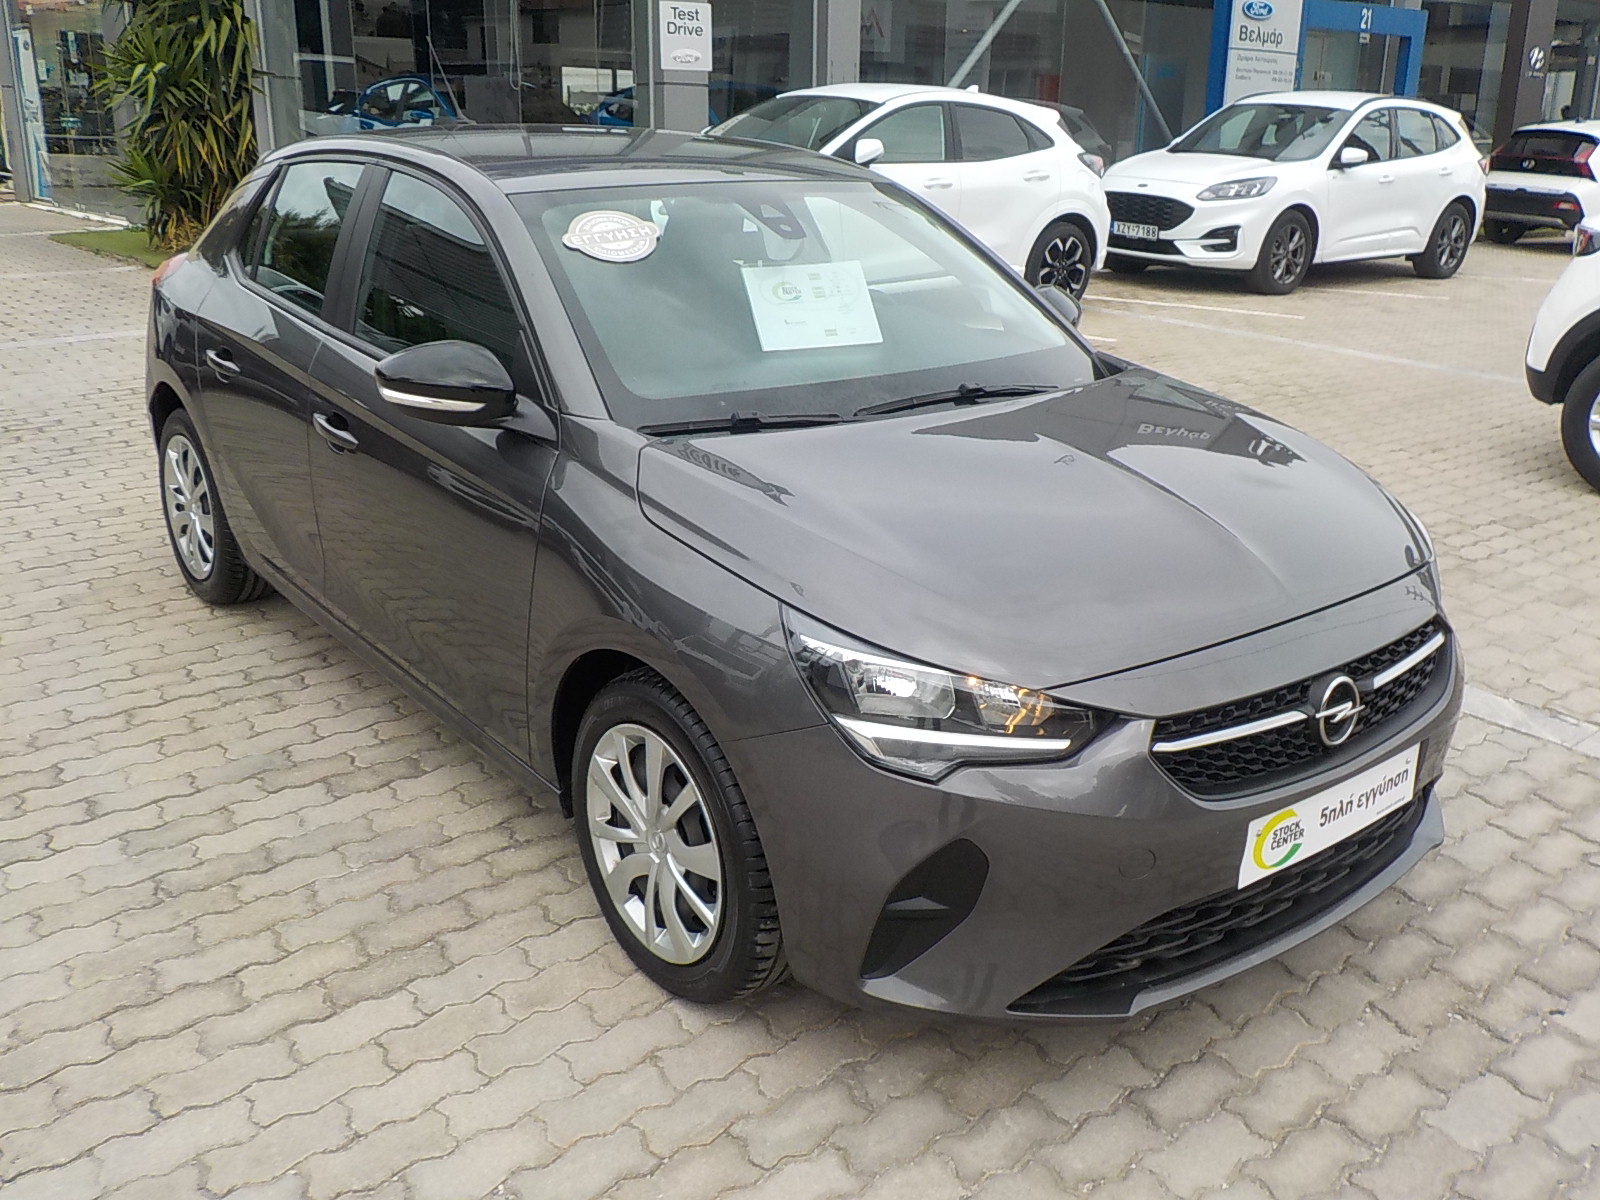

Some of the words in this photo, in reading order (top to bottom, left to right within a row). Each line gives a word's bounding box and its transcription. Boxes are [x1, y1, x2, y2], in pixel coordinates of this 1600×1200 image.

[670, 6, 700, 21] Test
[1250, 1, 1269, 15] Ford
[1360, 7, 1373, 30] 21
[667, 21, 703, 37] Drive
[1239, 25, 1283, 47] Βελμάρ
[570, 226, 653, 245] ΕΓΓΥΗΣΗ
[1319, 792, 1354, 828] 5πλή
[1356, 768, 1409, 811] εγγύηση
[1270, 828, 1305, 852] CENTER
[1272, 818, 1301, 840] STOCK
